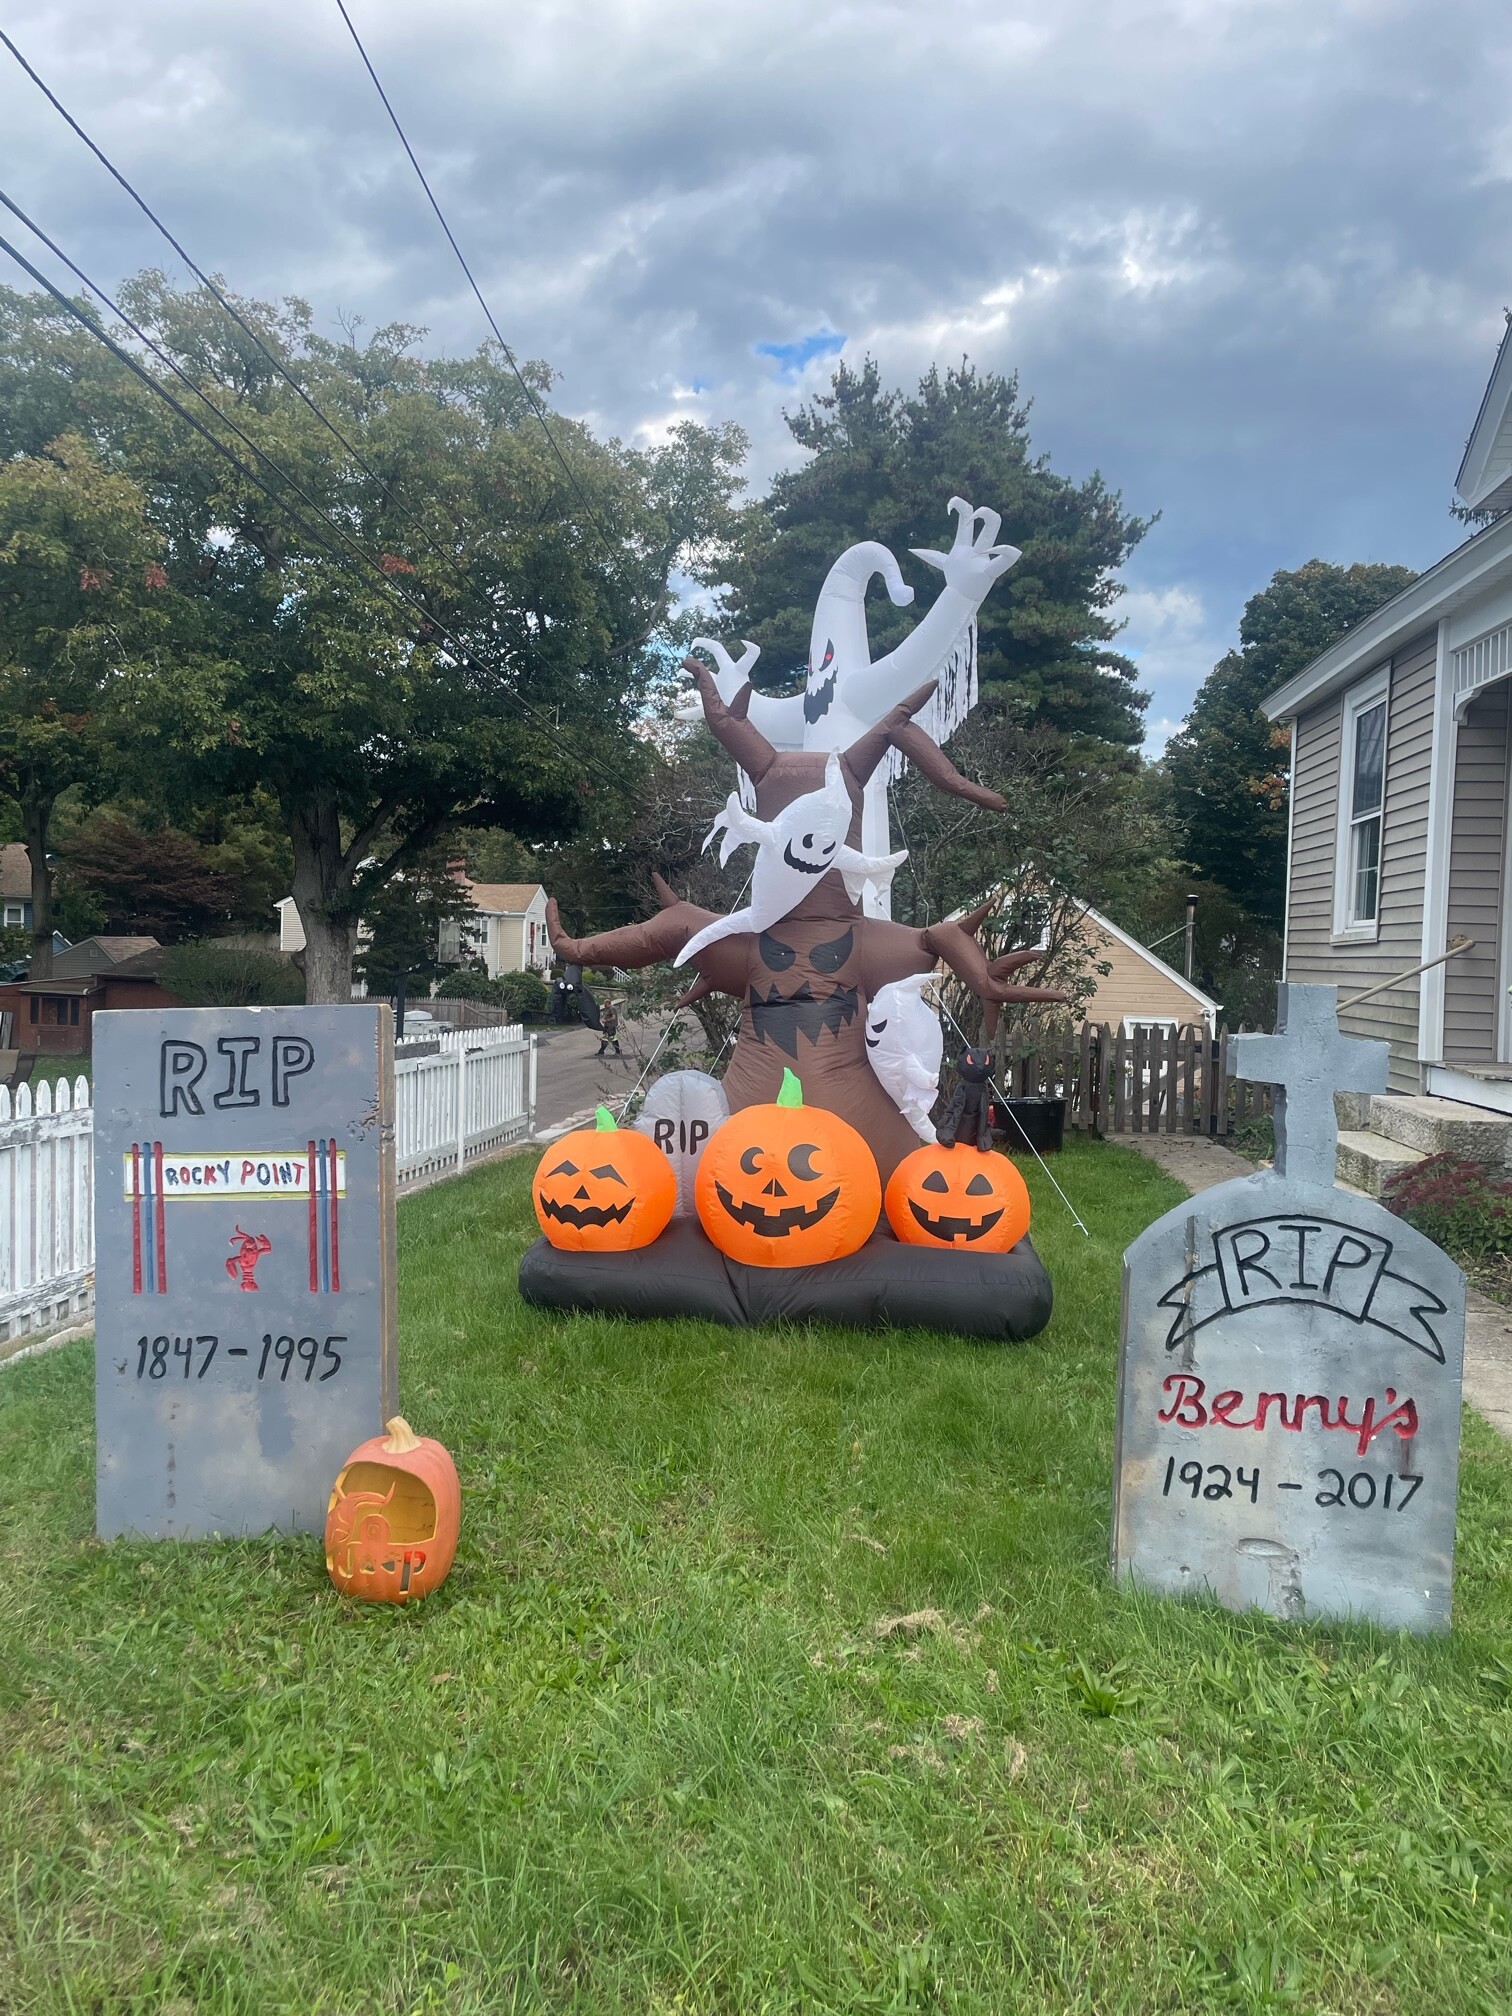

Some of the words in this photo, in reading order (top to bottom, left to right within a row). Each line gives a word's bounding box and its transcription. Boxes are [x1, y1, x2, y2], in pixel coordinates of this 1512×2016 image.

[160, 1036, 315, 1118] RIP
[654, 1119, 708, 1155] RIP
[165, 1160, 231, 1186] ROCKY
[240, 1160, 305, 1186] POINT
[1231, 1225, 1373, 1296] RIP
[1158, 1374, 1419, 1456] Benny's
